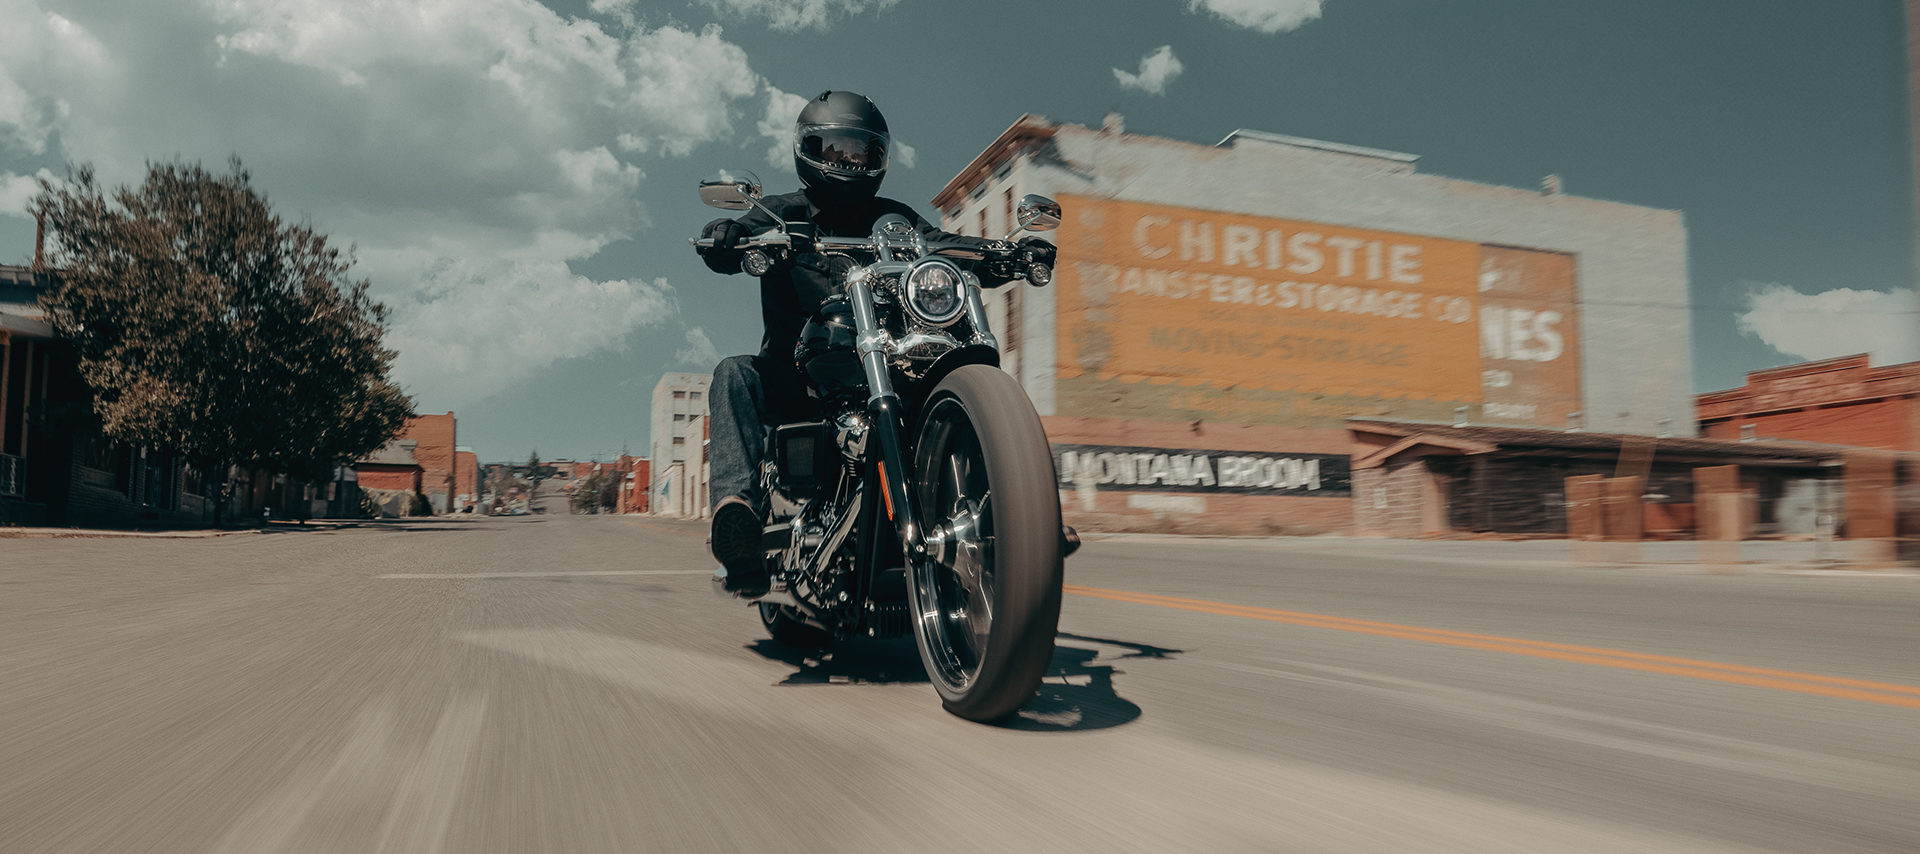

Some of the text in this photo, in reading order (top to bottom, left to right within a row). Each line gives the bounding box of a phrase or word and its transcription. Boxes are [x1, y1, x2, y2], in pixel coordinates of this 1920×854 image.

[1133, 214, 1423, 284] CHRISTIE
[1275, 280, 1424, 319] STORAGE
[1061, 450, 1320, 491] MONTANA BROOM
